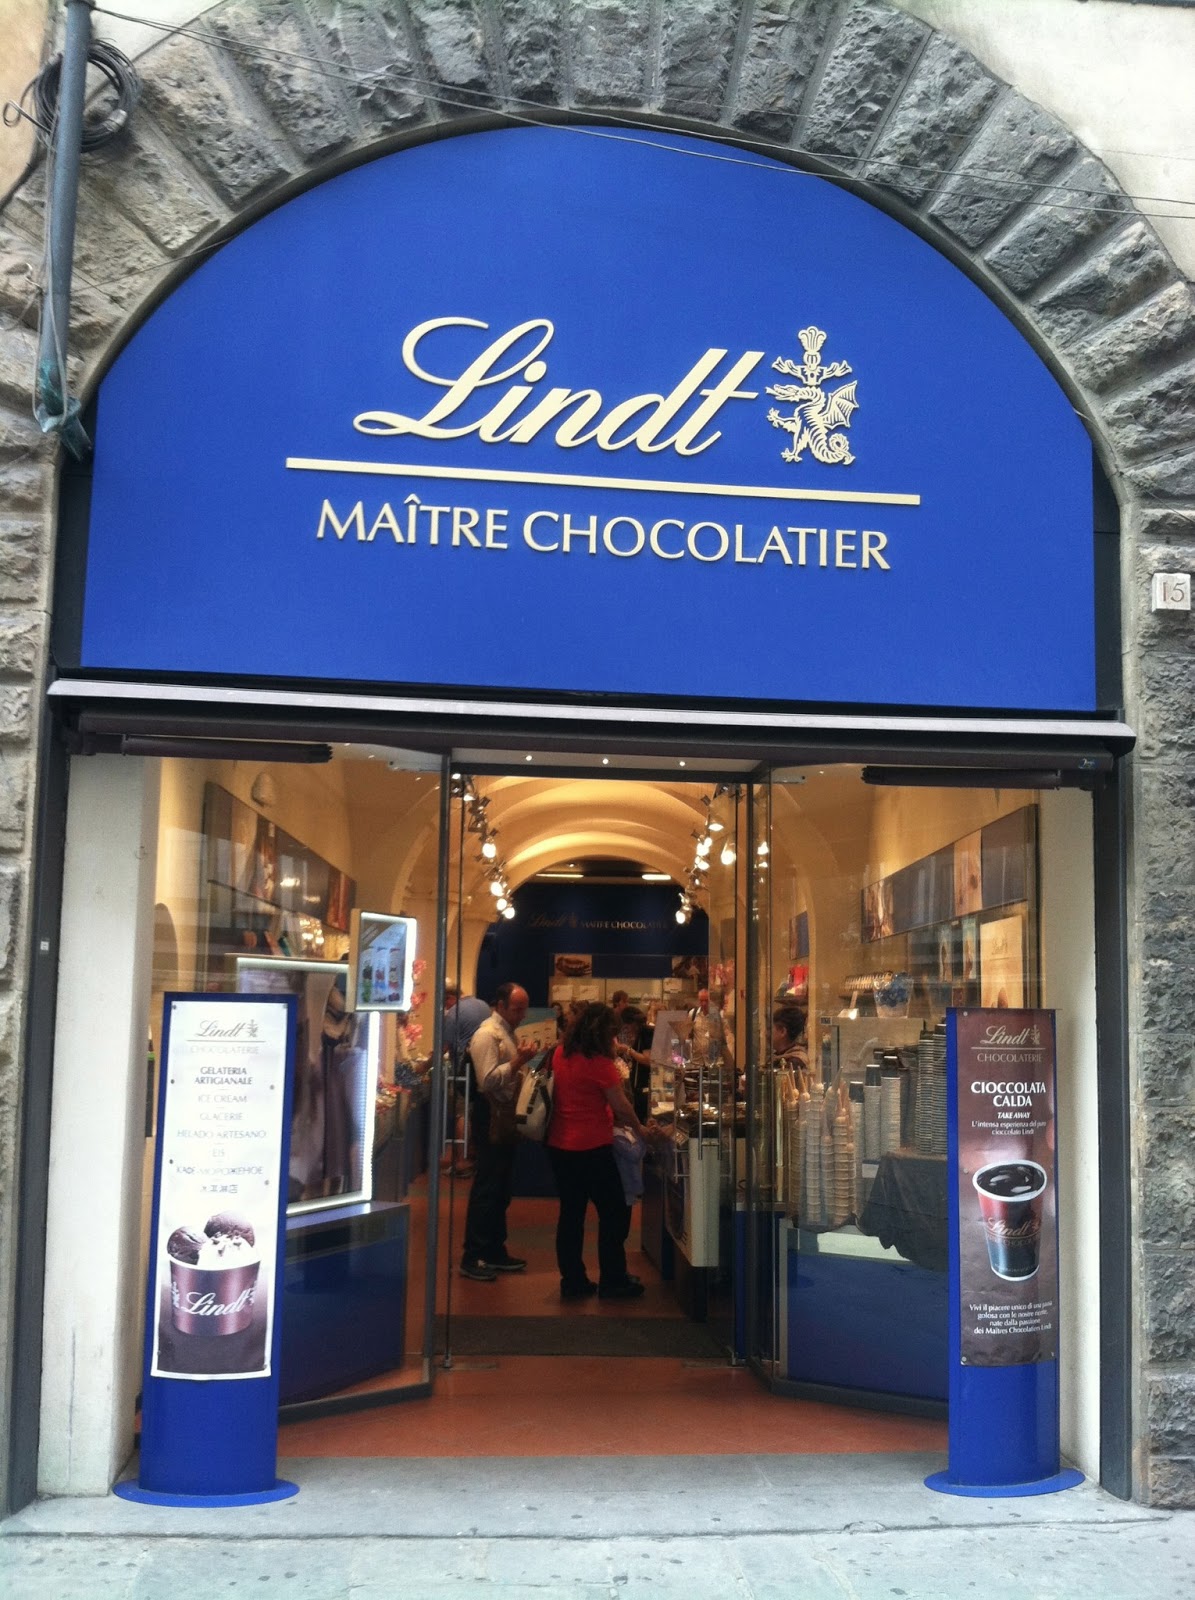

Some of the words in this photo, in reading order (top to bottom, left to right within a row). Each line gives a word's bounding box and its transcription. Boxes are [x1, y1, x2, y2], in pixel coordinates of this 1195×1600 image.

[353, 316, 765, 457] Lindt
[315, 494, 509, 549] MAÎTRE
[522, 510, 891, 571] CHOCOLATIER
[1162, 581, 1186, 602] 15
[195, 1019, 246, 1038] Lindt
[979, 1025, 1030, 1045] Lindt
[977, 1053, 1042, 1063] CHOCOLATERIE
[200, 1066, 247, 1075] GELATERIA
[194, 1076, 253, 1085] ARTIGIANALE
[970, 1081, 1047, 1094] CIOCCOLATA
[198, 1094, 212, 1103] ICE
[214, 1094, 248, 1103] CREAM
[992, 1095, 1033, 1107] CALDA
[997, 1111, 1013, 1119] TAKE
[1013, 1111, 1031, 1119] AWAY
[971, 1120, 999, 1128] L'intensa
[1000, 1120, 1029, 1129] esperienza
[177, 1129, 213, 1139] HELADO
[216, 1130, 267, 1139] ARTESANO
[181, 1287, 249, 1316] Lindt
[969, 1303, 982, 1311] Vivi
[988, 1303, 1010, 1313] piacere
[1011, 1303, 1027, 1311] unico
[977, 1312, 998, 1320] golosa
[1003, 1318, 1018, 1326] dalla
[1019, 1318, 1041, 1327] passione
[973, 1327, 984, 1335] dei
